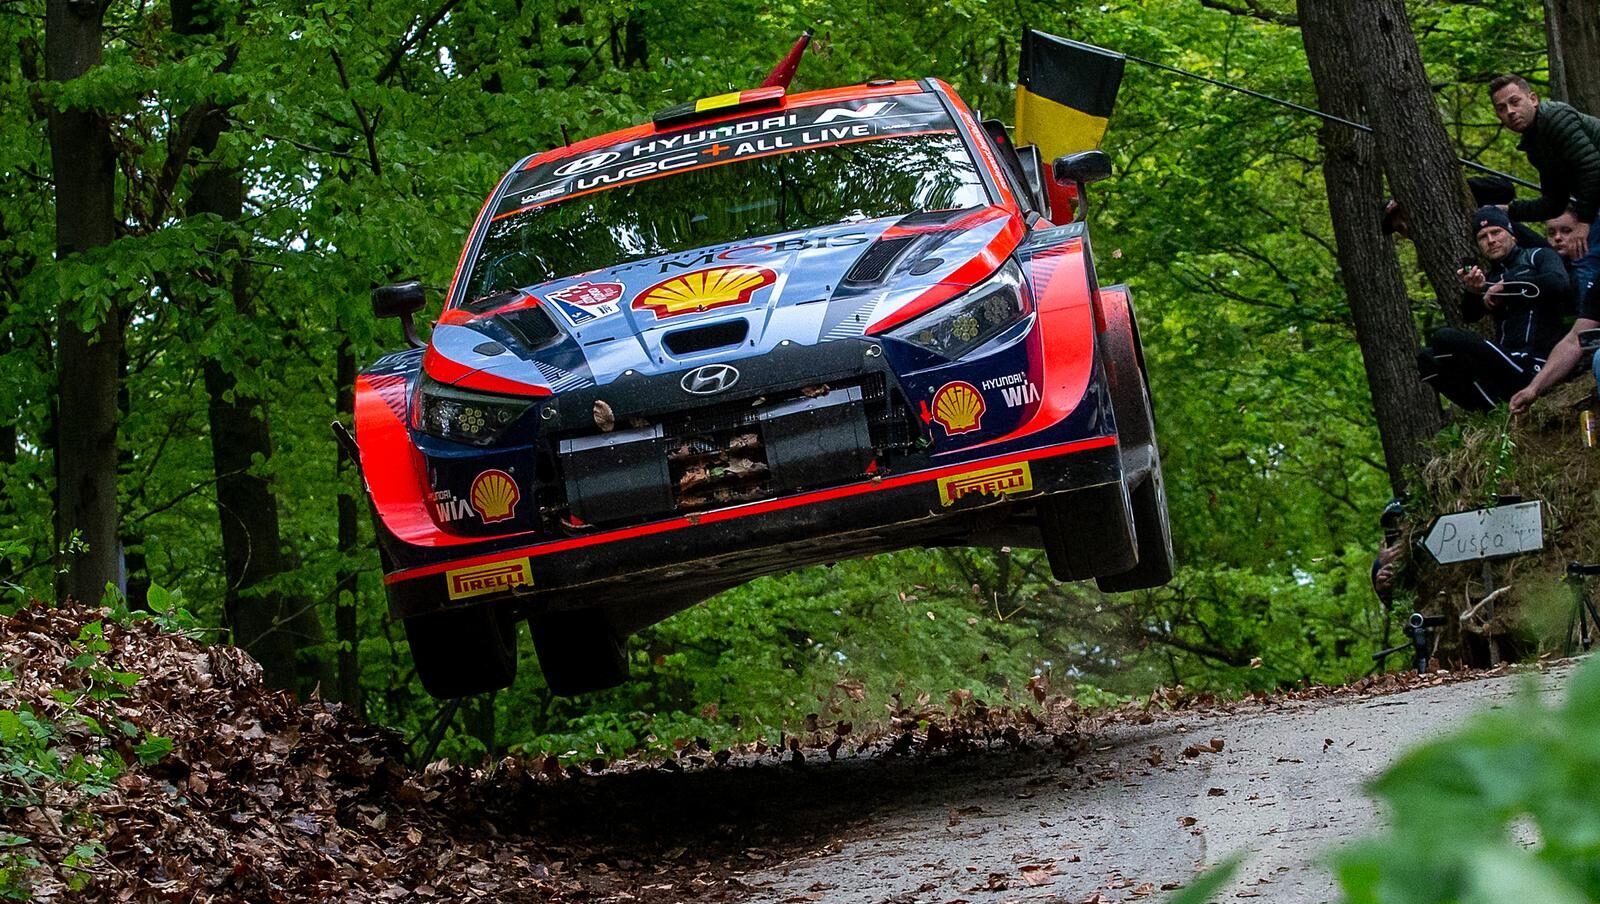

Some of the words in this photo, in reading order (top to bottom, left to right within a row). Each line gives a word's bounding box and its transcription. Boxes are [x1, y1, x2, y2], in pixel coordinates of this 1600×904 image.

[633, 115, 796, 156] HYUNDAI
[734, 136, 792, 156] ALL
[802, 124, 870, 143] LIVE
[657, 232, 870, 274] MOBIS
[982, 373, 1023, 391] HYUNDAI
[946, 468, 1024, 501] PIRELLI
[1435, 522, 1504, 556] Pušča
[452, 564, 525, 594] PIRELLI
